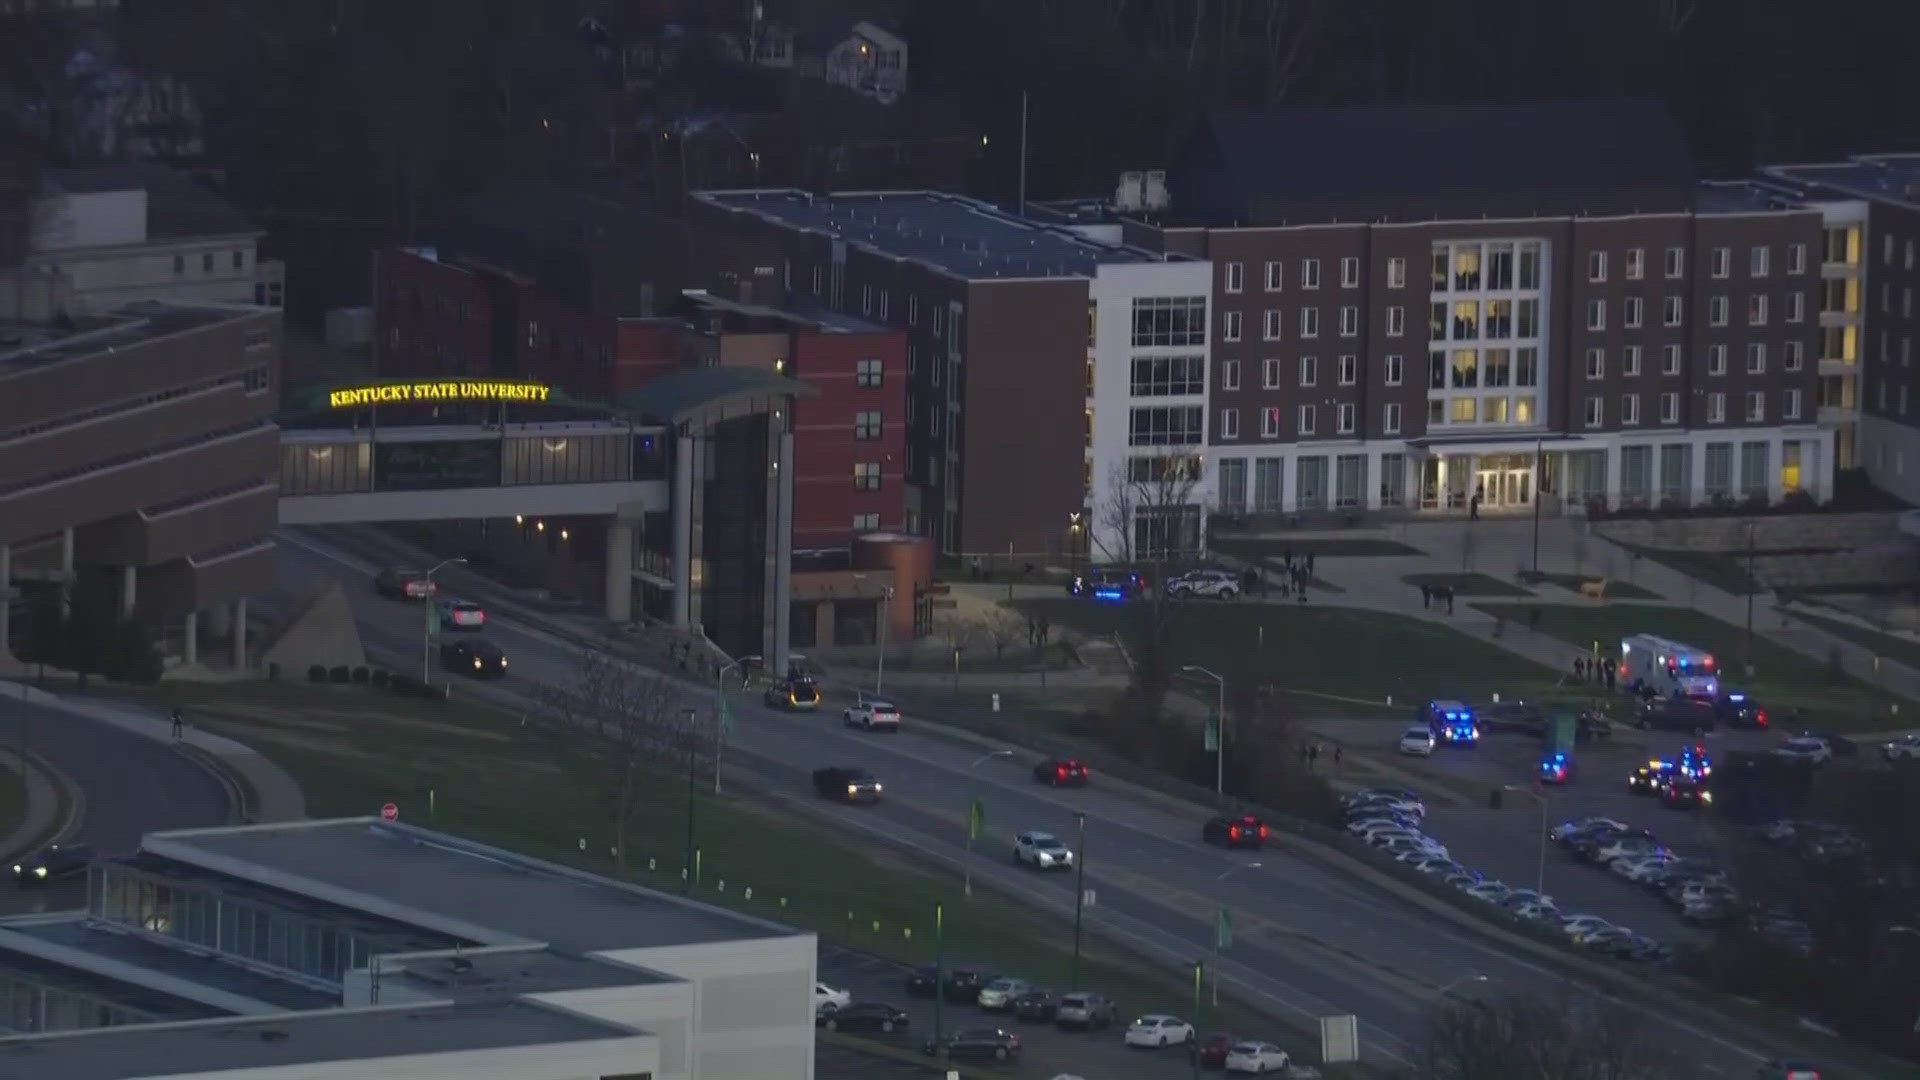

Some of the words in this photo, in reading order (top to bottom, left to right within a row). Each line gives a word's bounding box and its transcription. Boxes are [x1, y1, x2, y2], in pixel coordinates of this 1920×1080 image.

[330, 384, 411, 407] KENTUCKY
[413, 383, 458, 398] STATE
[460, 383, 549, 400] UNIVERSITY
